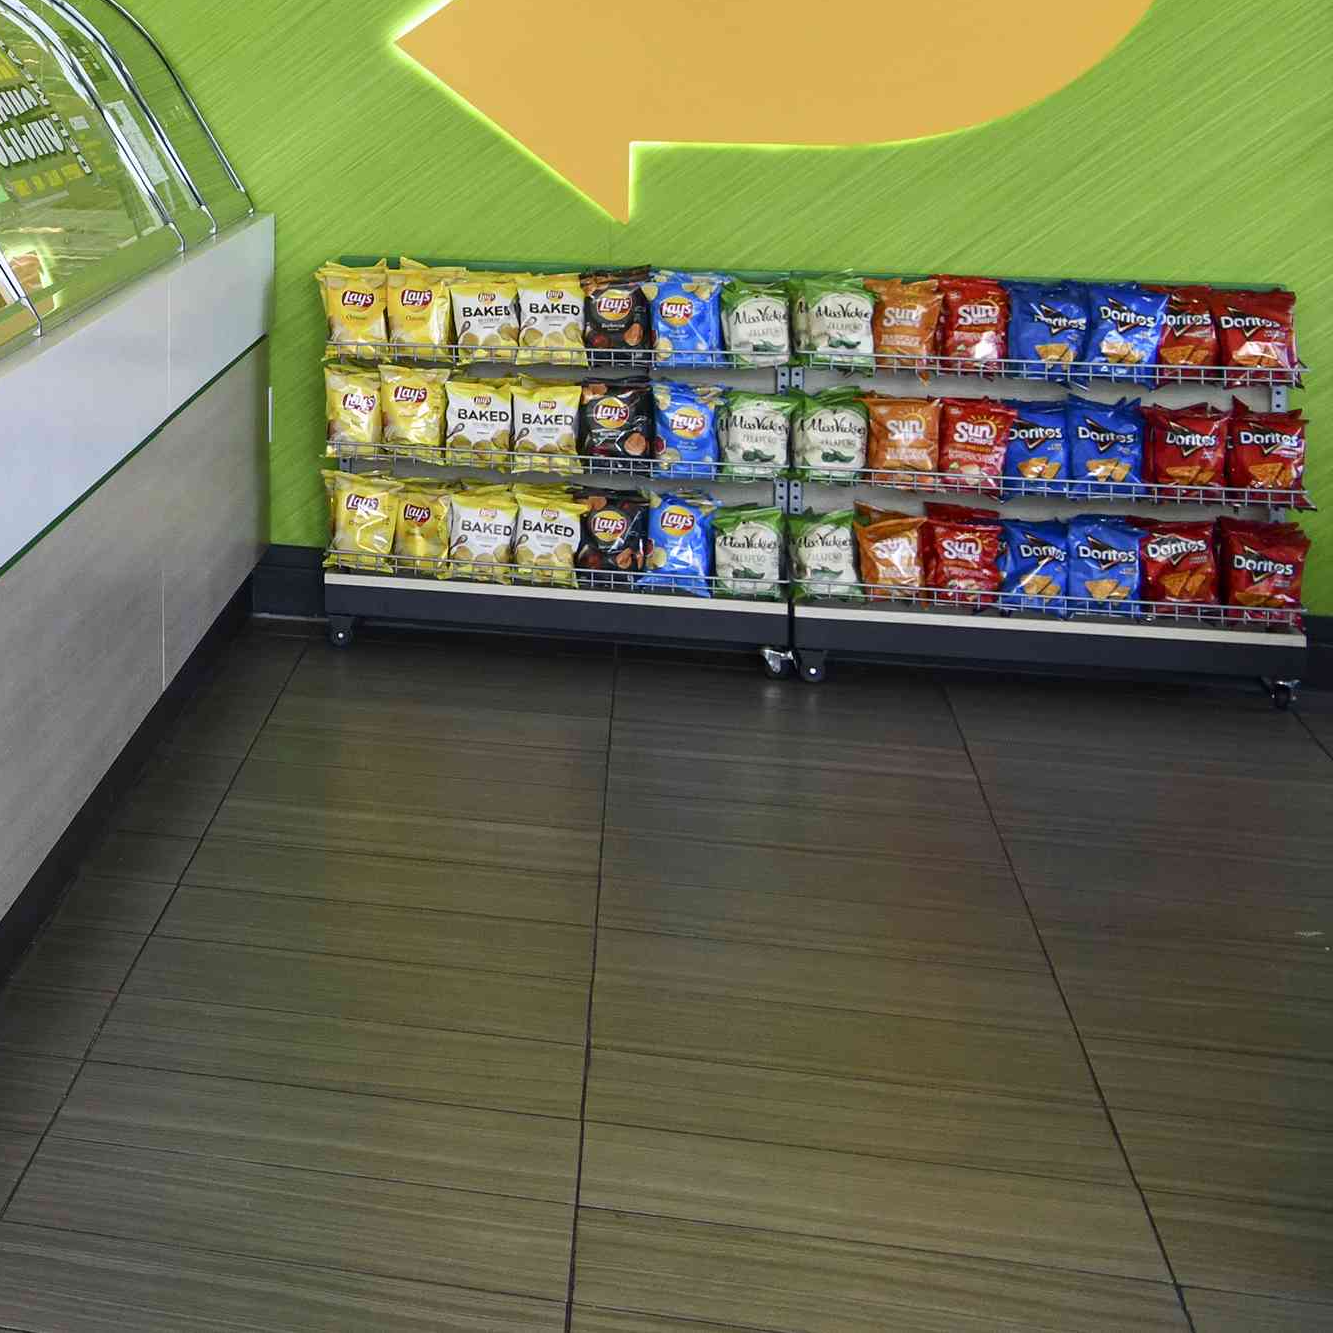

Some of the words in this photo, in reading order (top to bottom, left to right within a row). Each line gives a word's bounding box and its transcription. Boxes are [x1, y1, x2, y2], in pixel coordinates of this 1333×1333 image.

[529, 303, 584, 315] BAKED
[1100, 305, 1155, 328] Doritos
[1221, 315, 1281, 329] Doritos
[458, 409, 509, 422] BAKED
[522, 414, 574, 425] BAKED
[1010, 426, 1062, 441] Doritos
[1078, 427, 1133, 443] Doritos
[1167, 431, 1217, 446] Doritos
[1240, 430, 1298, 446] Doritos
[462, 520, 512, 536] BAKED
[522, 520, 573, 537] BAKED
[1020, 544, 1066, 561] Doritos
[1079, 545, 1137, 563] Doritos
[1148, 538, 1207, 557] Doritos
[1234, 555, 1294, 576] Doritos
